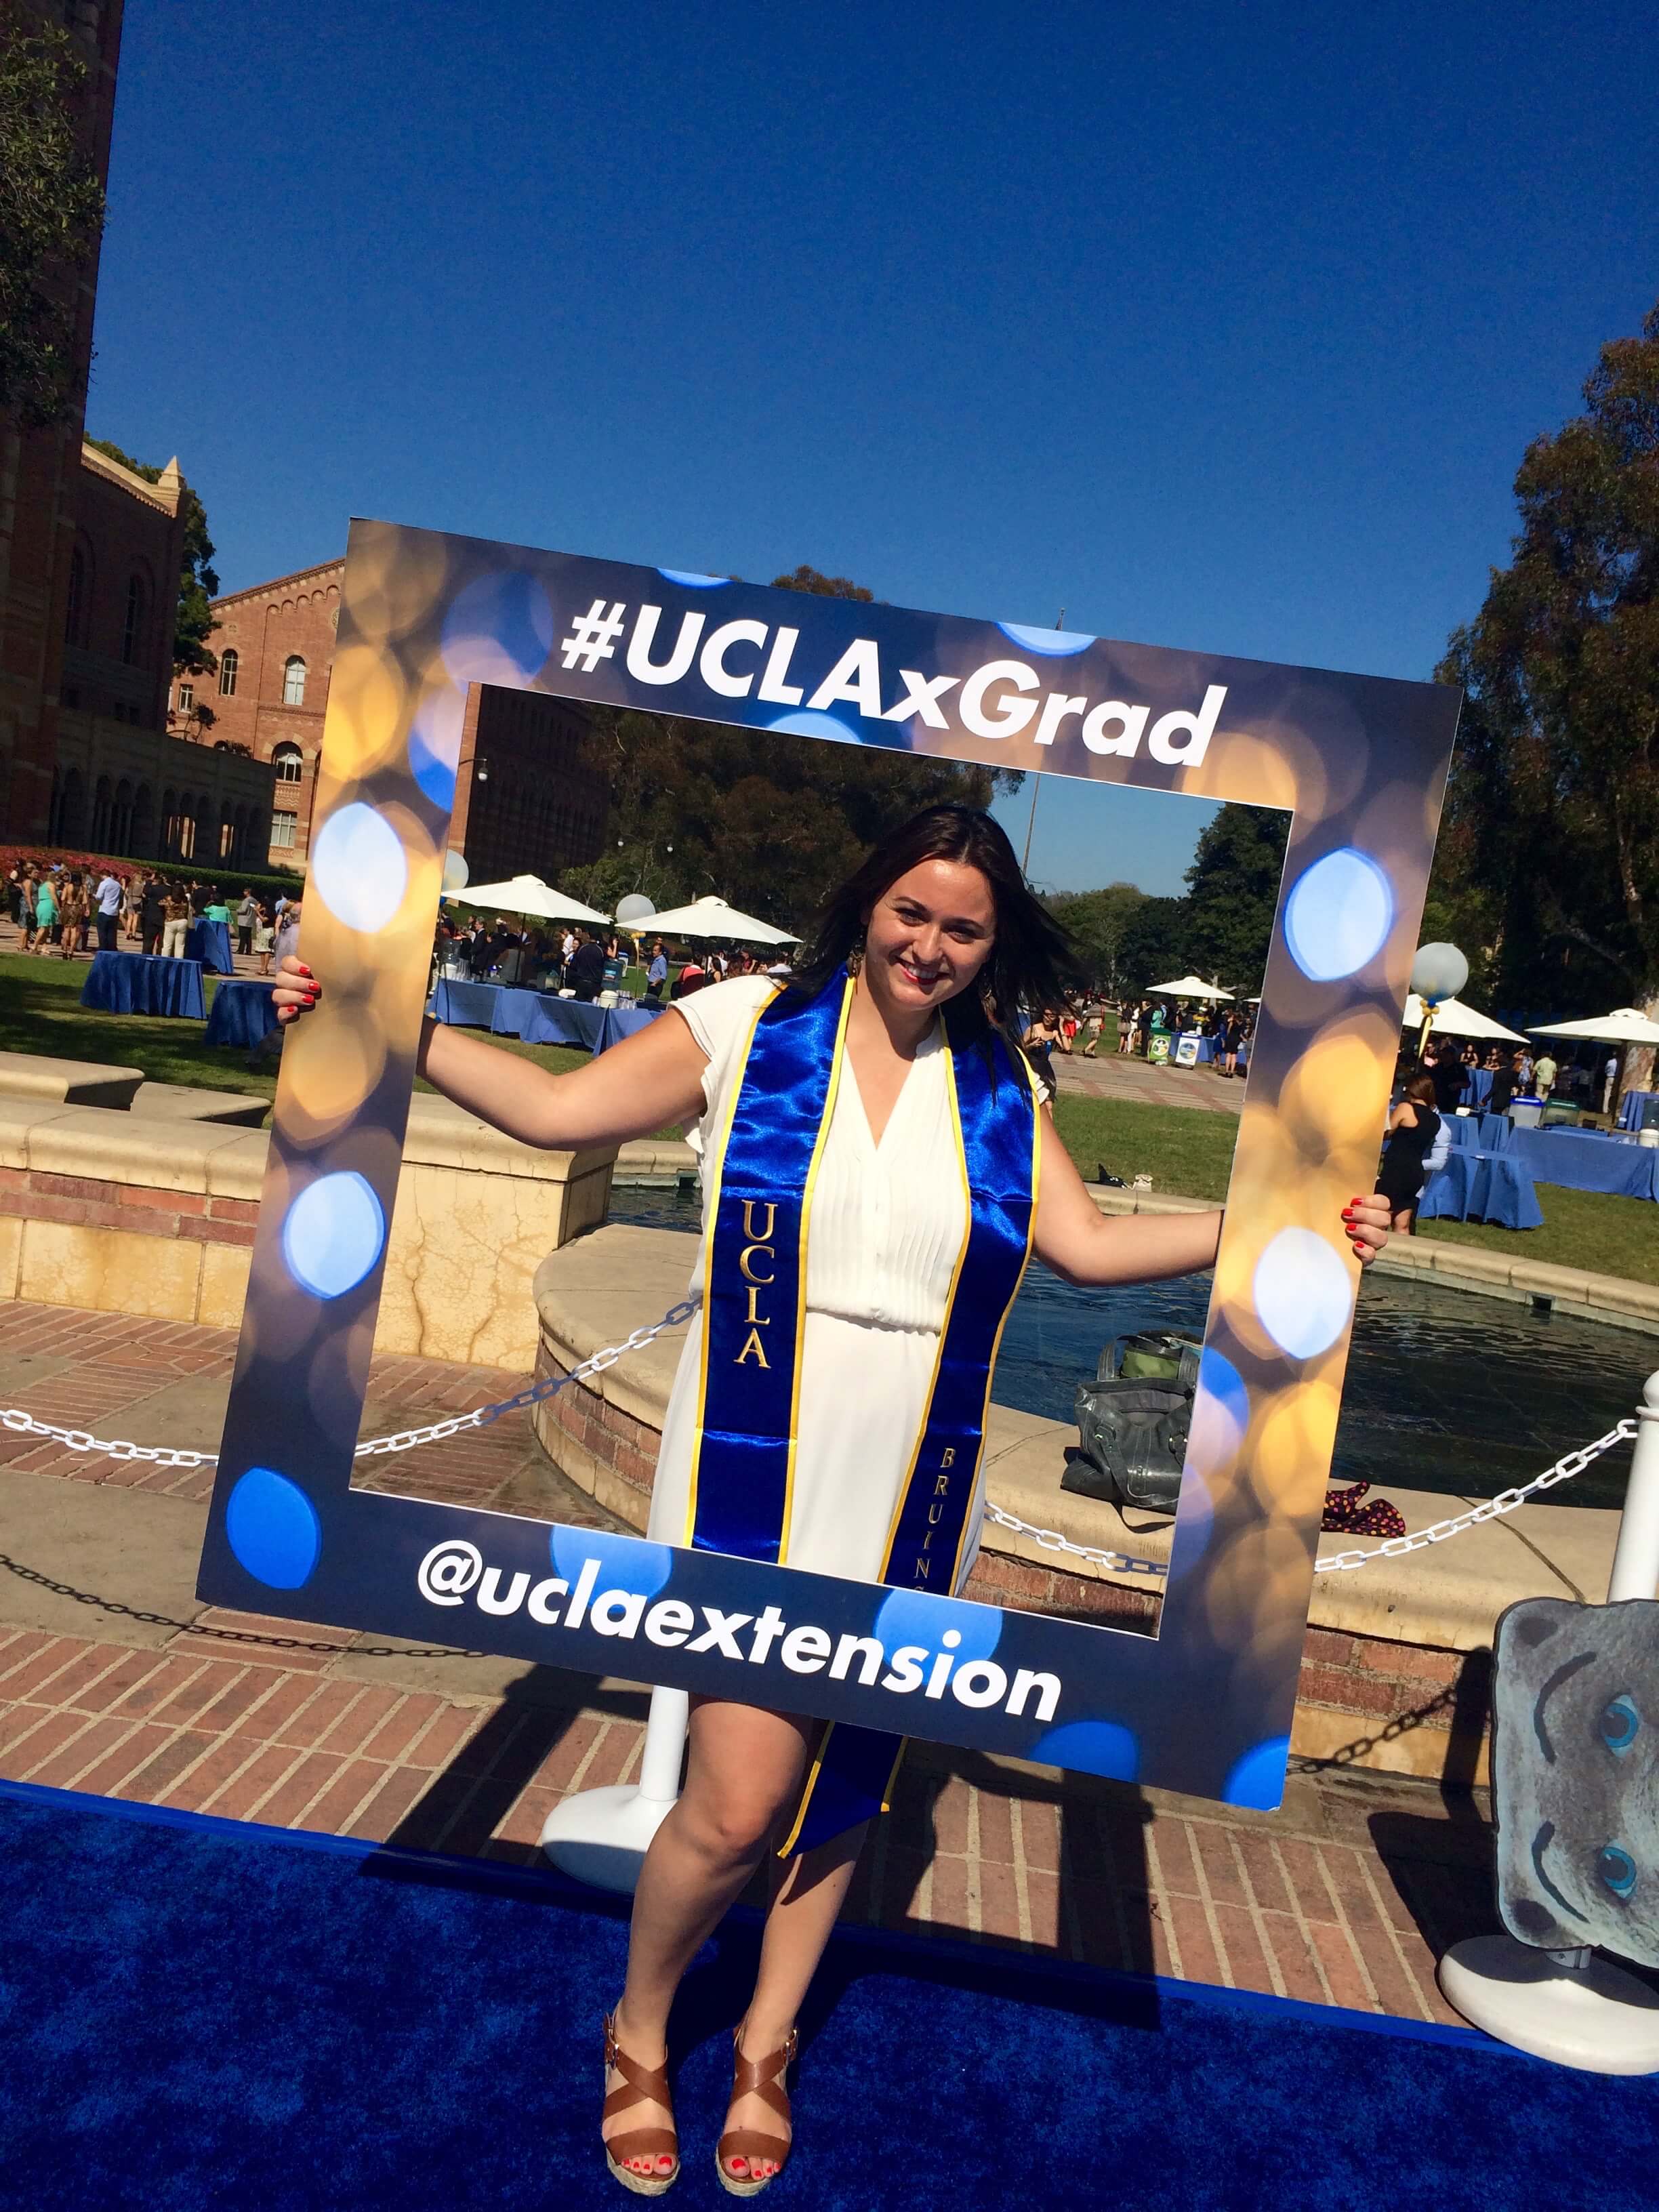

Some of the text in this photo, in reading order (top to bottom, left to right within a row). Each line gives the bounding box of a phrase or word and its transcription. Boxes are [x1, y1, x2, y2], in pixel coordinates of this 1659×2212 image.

[560, 599, 1228, 767] #UCLAxGrad
[733, 1199, 779, 1369] UCLA
[913, 1447, 956, 1591] BRUIN
[417, 1539, 1061, 1722] @uclaextension
